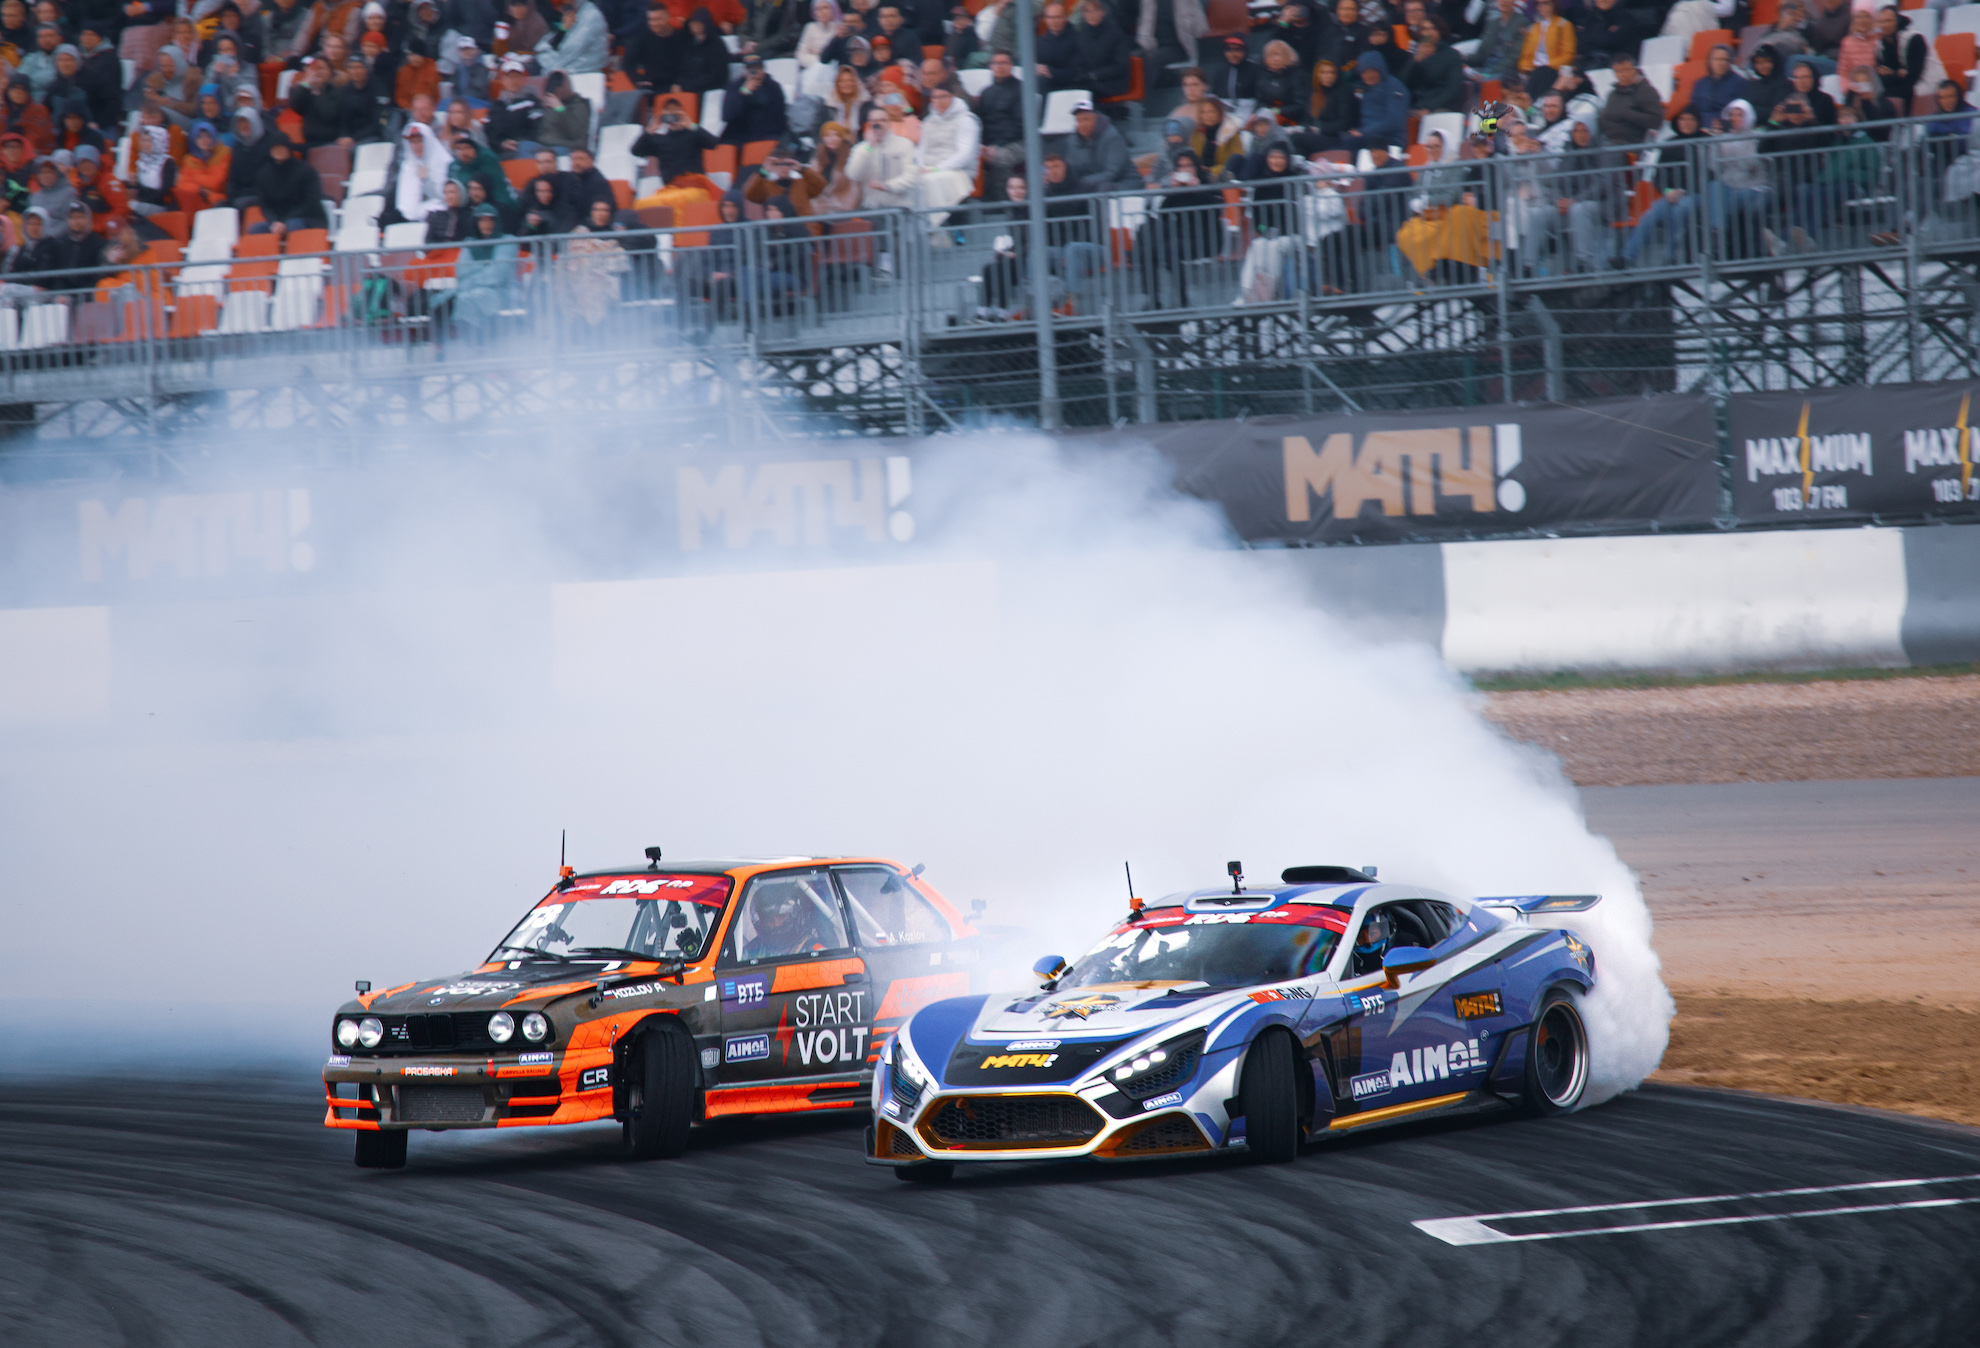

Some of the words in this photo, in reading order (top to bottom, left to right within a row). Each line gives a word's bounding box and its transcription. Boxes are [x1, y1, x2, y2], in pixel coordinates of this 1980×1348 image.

[1283, 423, 1526, 521] МАТЧ!
[675, 455, 916, 552] МАТЧ!
[1821, 484, 1849, 509] FM
[611, 984, 652, 999] KOZLOV
[653, 982, 666, 992] A.
[737, 982, 764, 1004] ВТБ
[795, 990, 866, 1028] START
[1454, 993, 1501, 1018] МАТЧ!
[728, 1040, 767, 1058] AIMOL
[797, 1027, 868, 1065] VOLT
[520, 1053, 551, 1063] AIMOL
[980, 1053, 1059, 1069] МАТЧ!
[1390, 1038, 1488, 1089] AIMOL
[583, 1068, 608, 1085] CR
[1354, 1075, 1391, 1096] AIMOL
[1146, 1093, 1180, 1109] AIMOL
